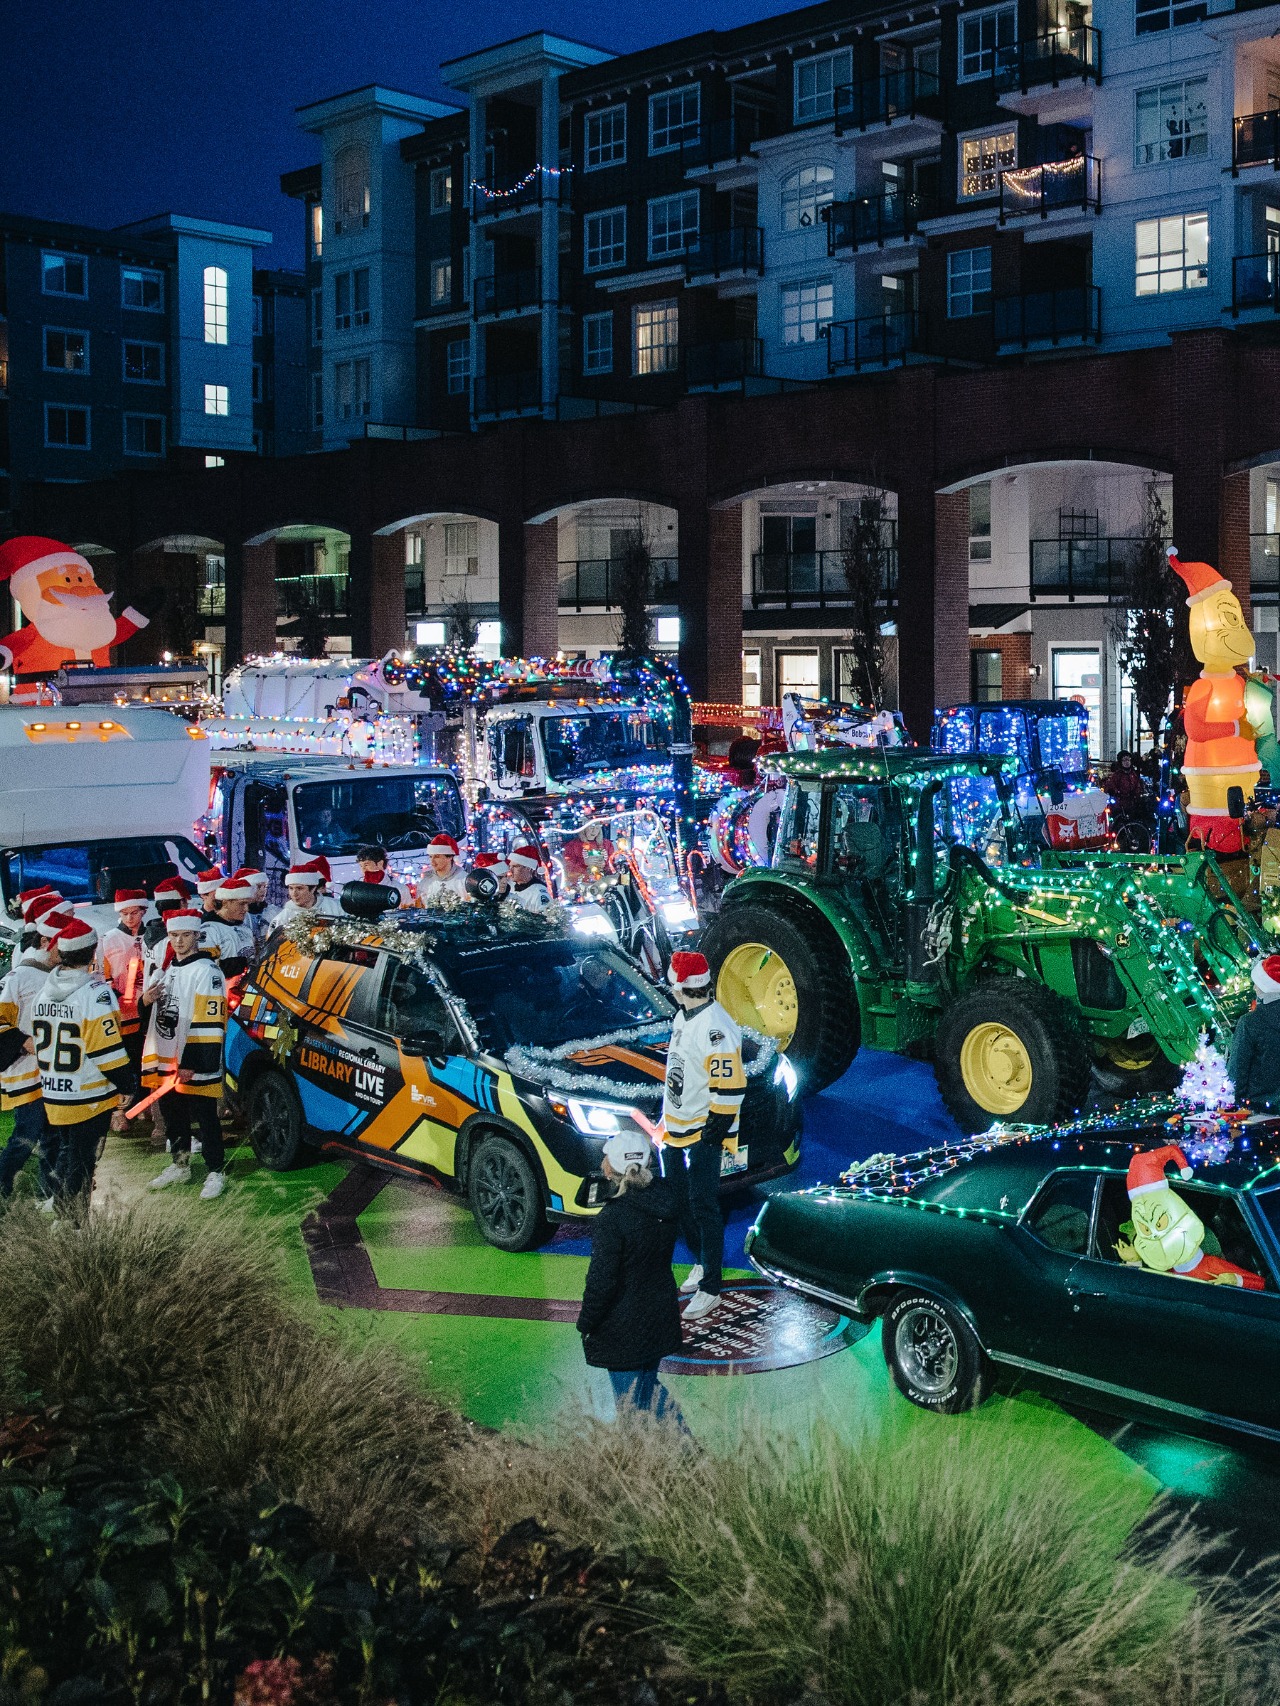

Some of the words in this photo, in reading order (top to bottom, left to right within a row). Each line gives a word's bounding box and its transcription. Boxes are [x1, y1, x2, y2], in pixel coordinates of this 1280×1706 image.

[32, 1019, 82, 1074] 26
[338, 1049, 364, 1067] REGIONAL
[363, 1059, 387, 1074] LIBRARY
[710, 1059, 734, 1078] 25
[300, 1047, 354, 1084] LIBRARY
[355, 1068, 385, 1097] LIVE
[726, 1291, 765, 1305] miles
[891, 1297, 946, 1320] BFGoodrich
[712, 1322, 769, 1347] Thunder
[741, 1320, 773, 1333] Day
[692, 1341, 733, 1357] Sept
[708, 1332, 749, 1350] miles
[908, 1388, 925, 1403] T/A
[927, 1386, 958, 1404] Radial
